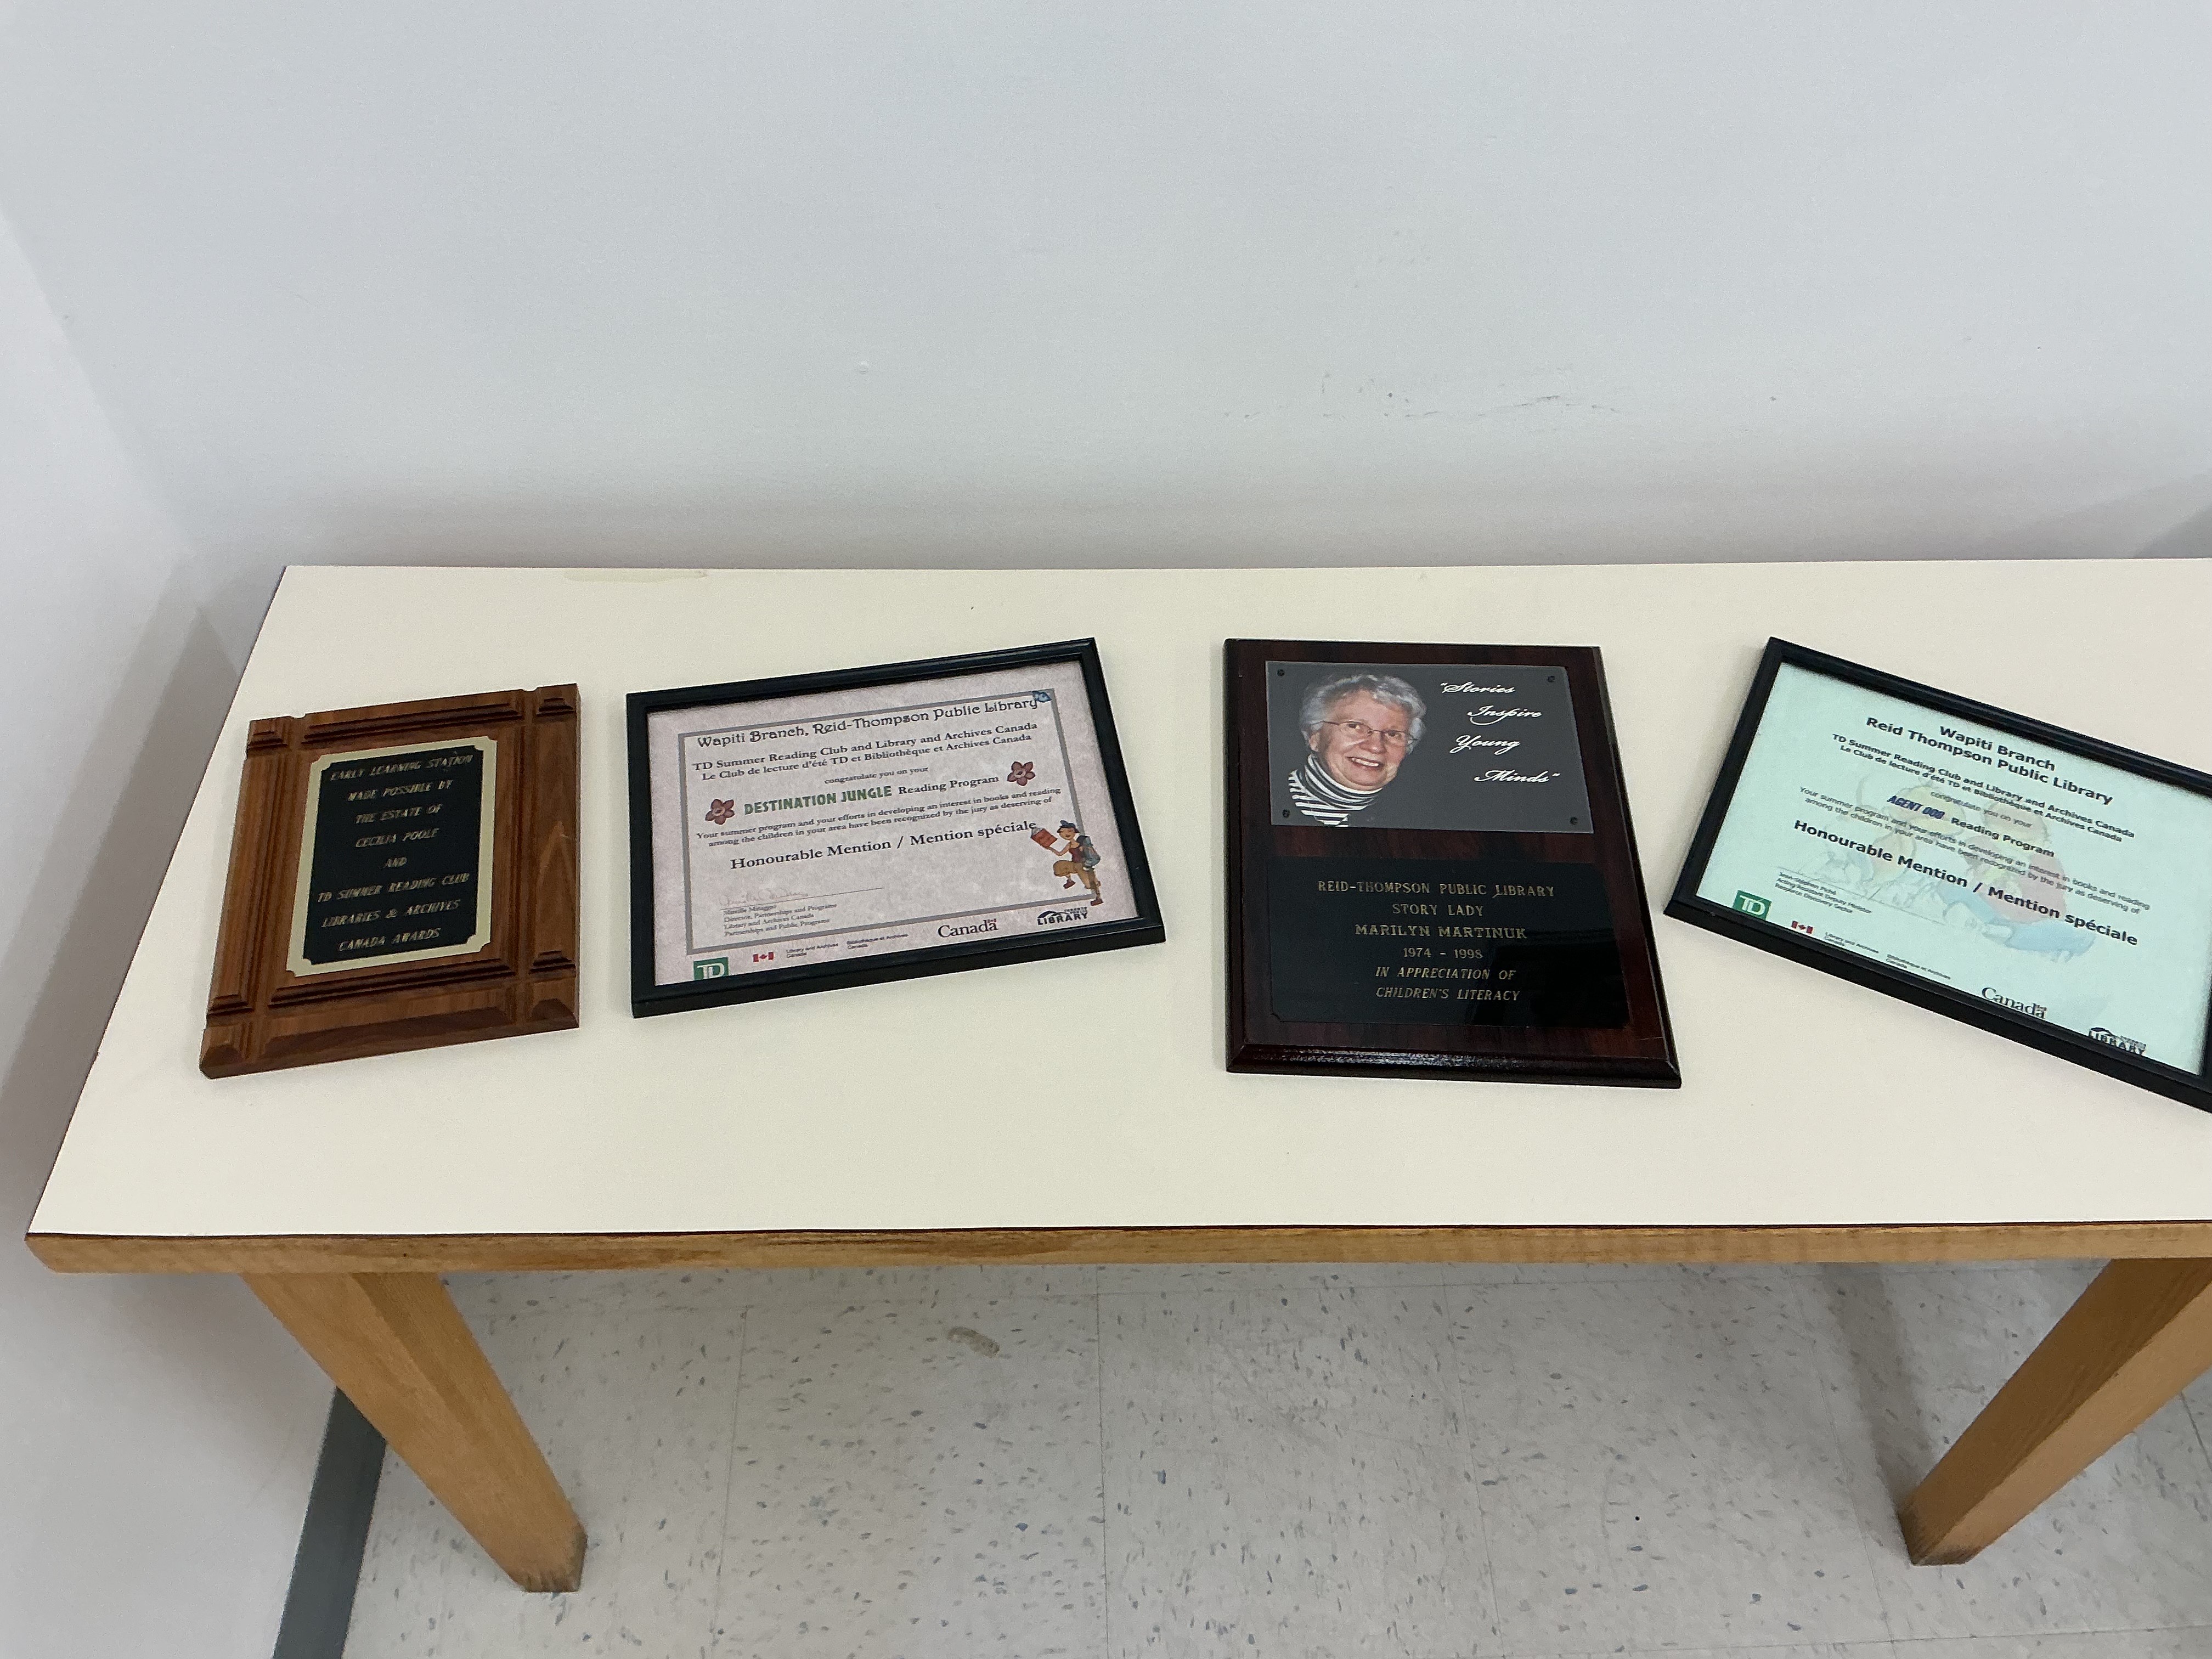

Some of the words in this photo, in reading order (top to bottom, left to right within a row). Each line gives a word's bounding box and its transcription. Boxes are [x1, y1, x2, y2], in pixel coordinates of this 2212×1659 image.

[697, 733, 745, 747] Wapiti
[750, 726, 809, 742] Branch,
[812, 713, 929, 734] Reid-Thompson
[933, 706, 980, 721] Public
[985, 696, 1039, 713] Library
[1468, 706, 1542, 725] Inspire
[692, 762, 713, 770] TD
[716, 758, 765, 768] Summer
[769, 751, 817, 761] Reading
[820, 746, 848, 755] Club
[851, 742, 872, 752] and
[876, 739, 916, 748] Library
[920, 734, 941, 743] and
[945, 730, 992, 740] Archives
[995, 723, 1037, 733] Canada
[719, 769, 744, 778] Club
[763, 764, 799, 773] lecture
[830, 757, 848, 765] TD
[864, 748, 930, 760] Bibliothèque
[946, 741, 990, 751] Archives
[992, 734, 1032, 744] Canada
[1449, 735, 1521, 755] Young
[1940, 726, 1993, 751] Wapiti
[1997, 745, 2055, 771] Branch
[330, 769, 363, 781] EARLY
[369, 761, 421, 776] LEARNING
[426, 755, 473, 768] STATION
[1866, 717, 1903, 736] Reid
[1908, 730, 1992, 765] Thompson
[1997, 759, 2049, 783] Public
[2053, 777, 2113, 805] Library
[825, 774, 877, 784] congratulate
[898, 783, 946, 794] Reading
[950, 777, 999, 788] Program
[1833, 733, 1847, 742] TD
[1848, 740, 1892, 757] Summer
[1894, 754, 1935, 773] Reading
[1938, 769, 1961, 780] Club
[1963, 778, 1983, 788] and
[1986, 784, 2023, 802] Library
[2025, 798, 2045, 808] and
[2047, 805, 2092, 823] Archives
[2095, 820, 2135, 838] Canada
[348, 789, 377, 801] MADE
[382, 782, 433, 797] POSSIBLE
[438, 780, 453, 789] BY
[744, 793, 837, 815] DESTINATION
[841, 786, 892, 802] JUNGLE
[356, 814, 374, 823] THE
[380, 807, 422, 821] ESTATE
[428, 804, 443, 814] OF
[720, 828, 757, 836] summer
[758, 823, 795, 833] program
[816, 817, 836, 826] your
[878, 806, 925, 816] developing
[939, 800, 971, 808] interest
[757, 832, 793, 840] children
[806, 828, 826, 836] your
[894, 811, 941, 823] recognized
[1001, 800, 1041, 808] deserving
[356, 834, 396, 847] CECILIA
[402, 828, 439, 841] POOLE
[731, 849, 822, 869] Honourable
[827, 842, 891, 856] Mention
[910, 830, 973, 845] Mention
[978, 821, 1038, 838] spéciale
[1951, 817, 1999, 840] Reading
[2003, 834, 2055, 857] Program
[386, 857, 407, 867] AND
[318, 892, 332, 902] TD
[337, 885, 382, 900] SUMMER
[388, 877, 437, 892] READING
[442, 873, 470, 885] CLUB
[1318, 881, 1430, 894] REID-THOMPSON
[1440, 884, 1486, 895] PUBLIC
[1494, 885, 1555, 897] LIBRARY
[1794, 820, 1893, 861] Honourable
[1898, 855, 1967, 887] Mention
[1988, 887, 2059, 918] Mention
[2064, 915, 2137, 945] spéciale
[321, 910, 381, 927] LIBRARIES
[406, 899, 460, 915] ARCHIVES
[1037, 913, 1088, 926] LIBRARY
[1392, 904, 1437, 915] STORY
[1448, 905, 1484, 916] LADY
[938, 918, 998, 938] Canada
[1355, 924, 1430, 936] MARILYN
[1438, 926, 1527, 939] MARTINUK
[339, 936, 385, 951] CANADA
[393, 928, 441, 943] AWARDS
[1403, 947, 1432, 958] 1974
[1454, 949, 1483, 959] 1998
[697, 963, 725, 979] TD
[1375, 966, 1389, 978] IN
[1397, 967, 1491, 980] APPRECIATION
[1499, 970, 1516, 980] OF
[1376, 987, 1449, 999] CHILDREN'S
[1457, 989, 1521, 1001] LITERACY
[1982, 987, 2047, 1019] Canada
